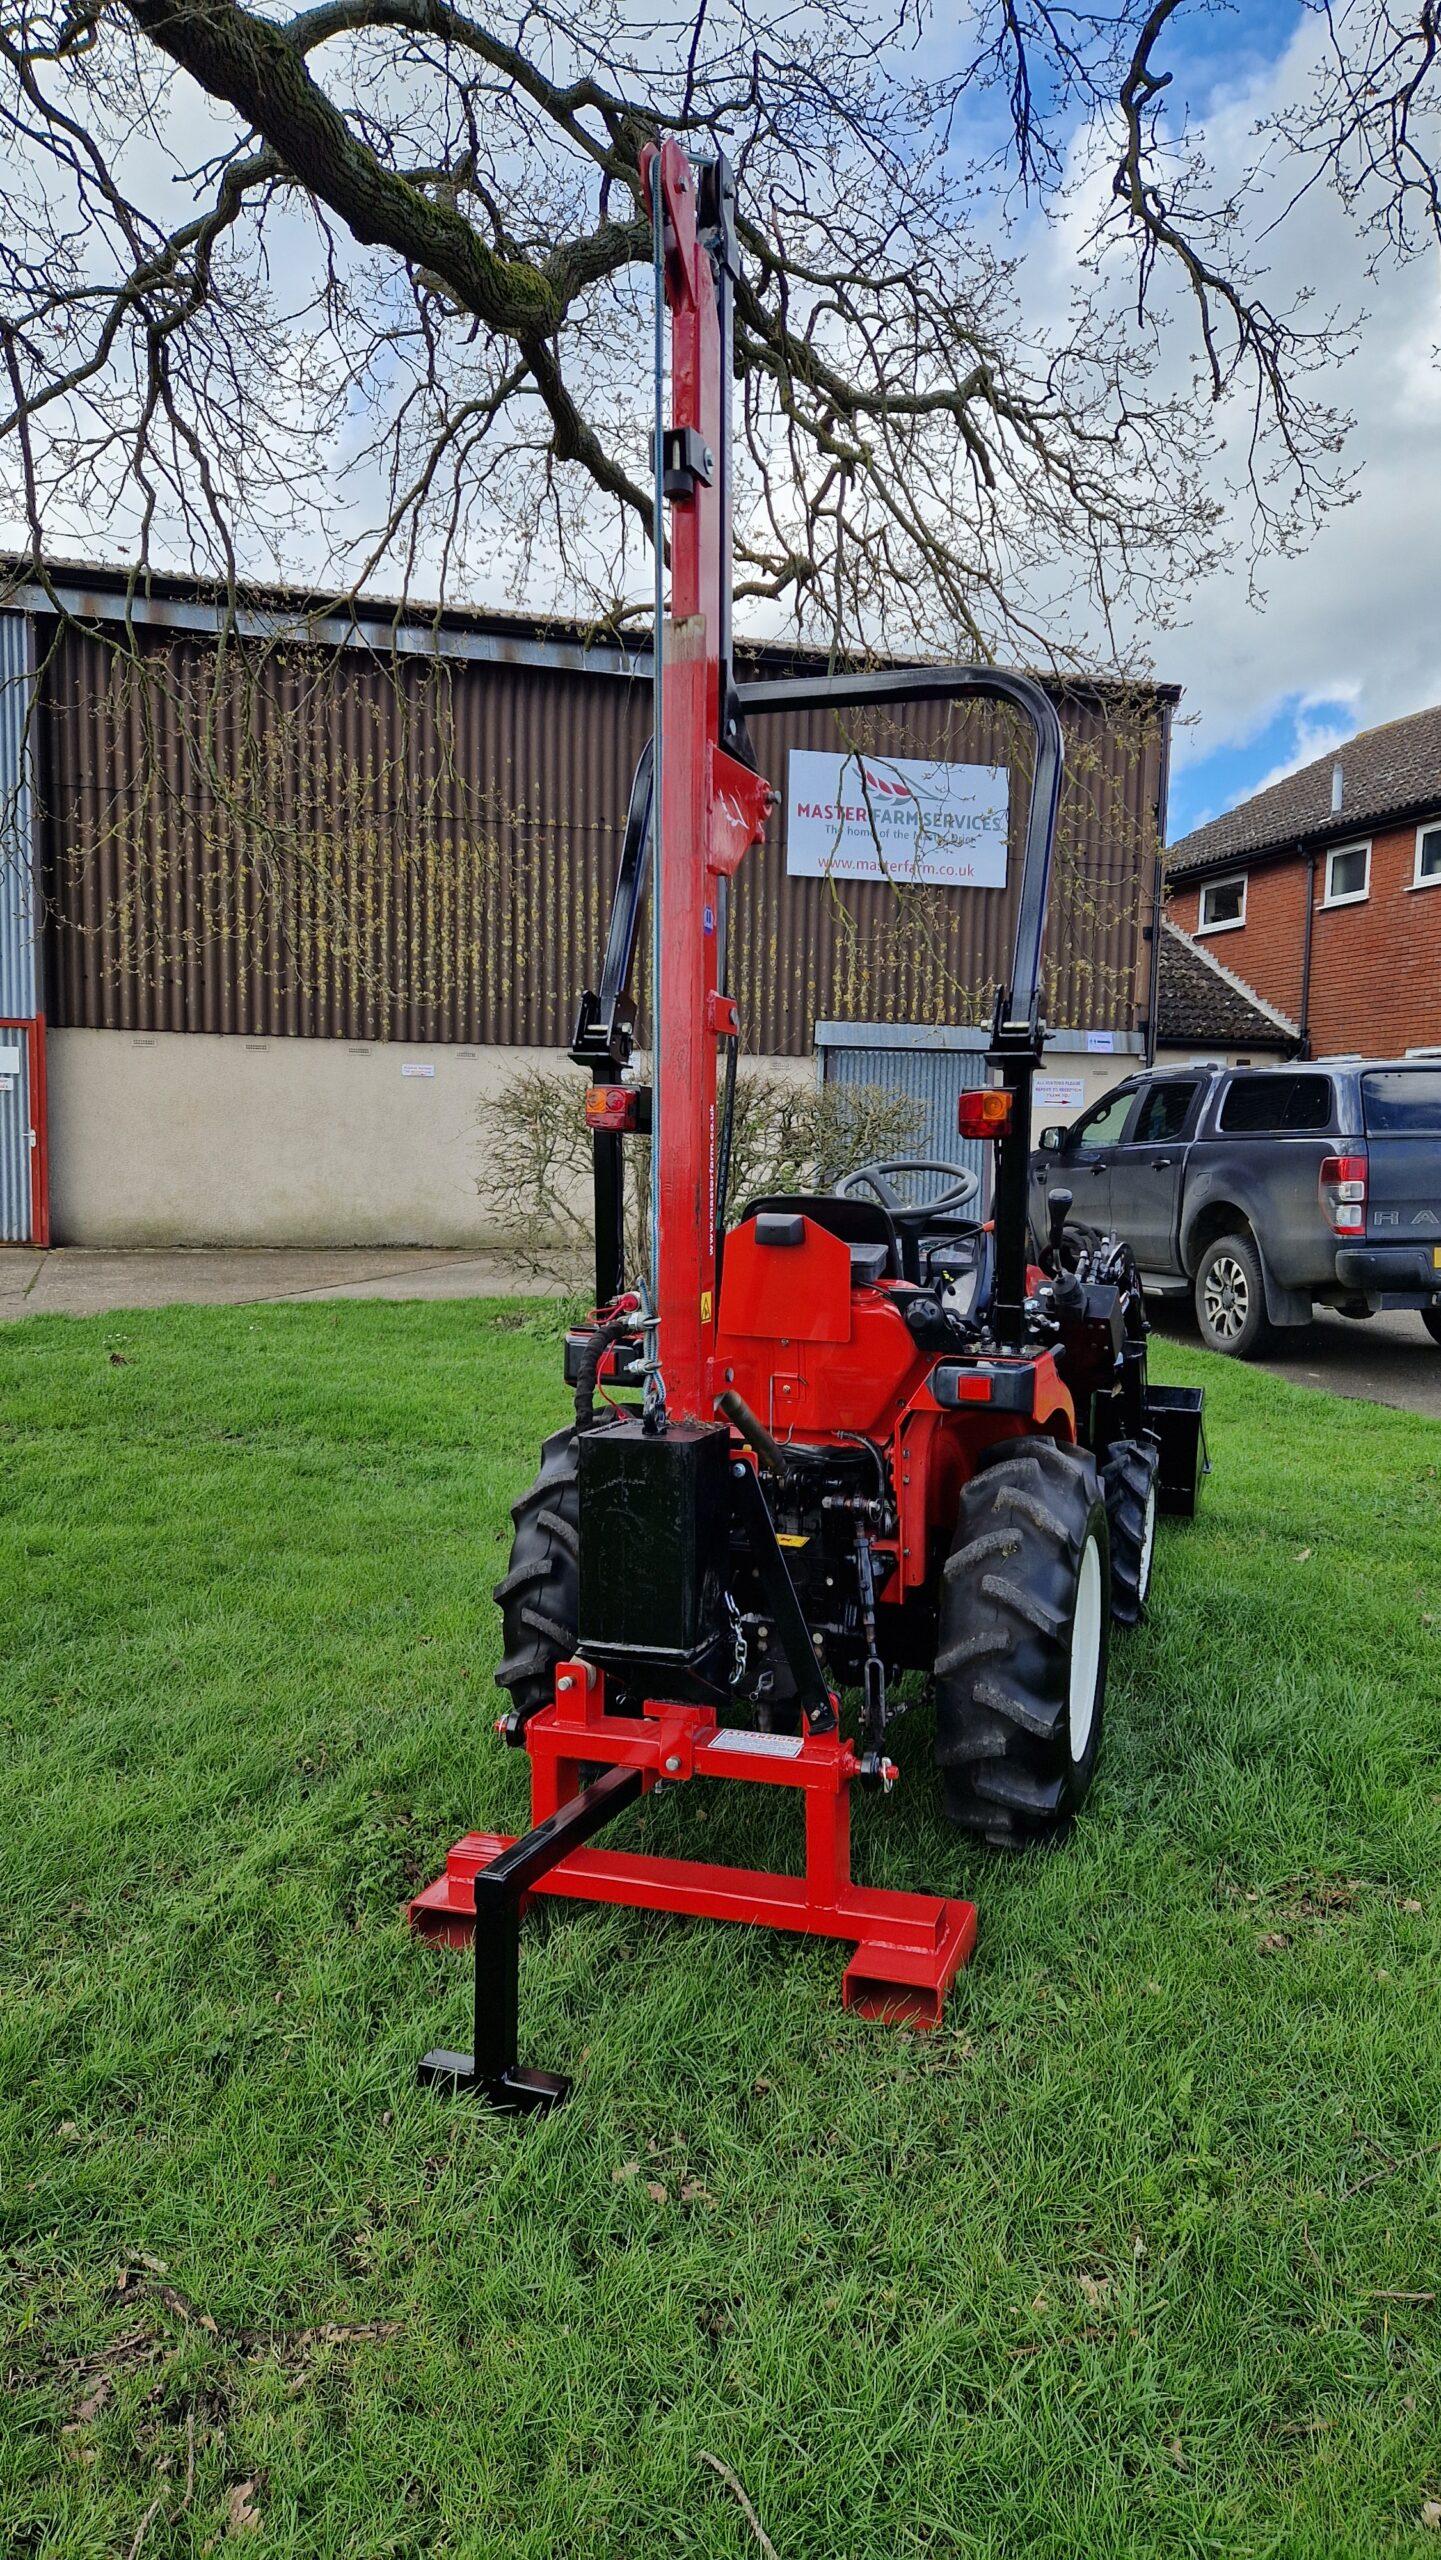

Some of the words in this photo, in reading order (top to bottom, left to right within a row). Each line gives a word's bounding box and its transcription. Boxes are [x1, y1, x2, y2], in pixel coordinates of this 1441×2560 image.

[797, 803, 867, 822] MASTER
[874, 809, 918, 826] FARM
[923, 812, 1001, 832] SERVICES
[825, 824, 843, 836] Th
[847, 826, 875, 837] hom
[880, 829, 890, 838] of
[893, 829, 909, 840] the
[818, 857, 975, 877] www.materfarm.co.uk
[726, 1730, 802, 1744] ATTENZIONE
